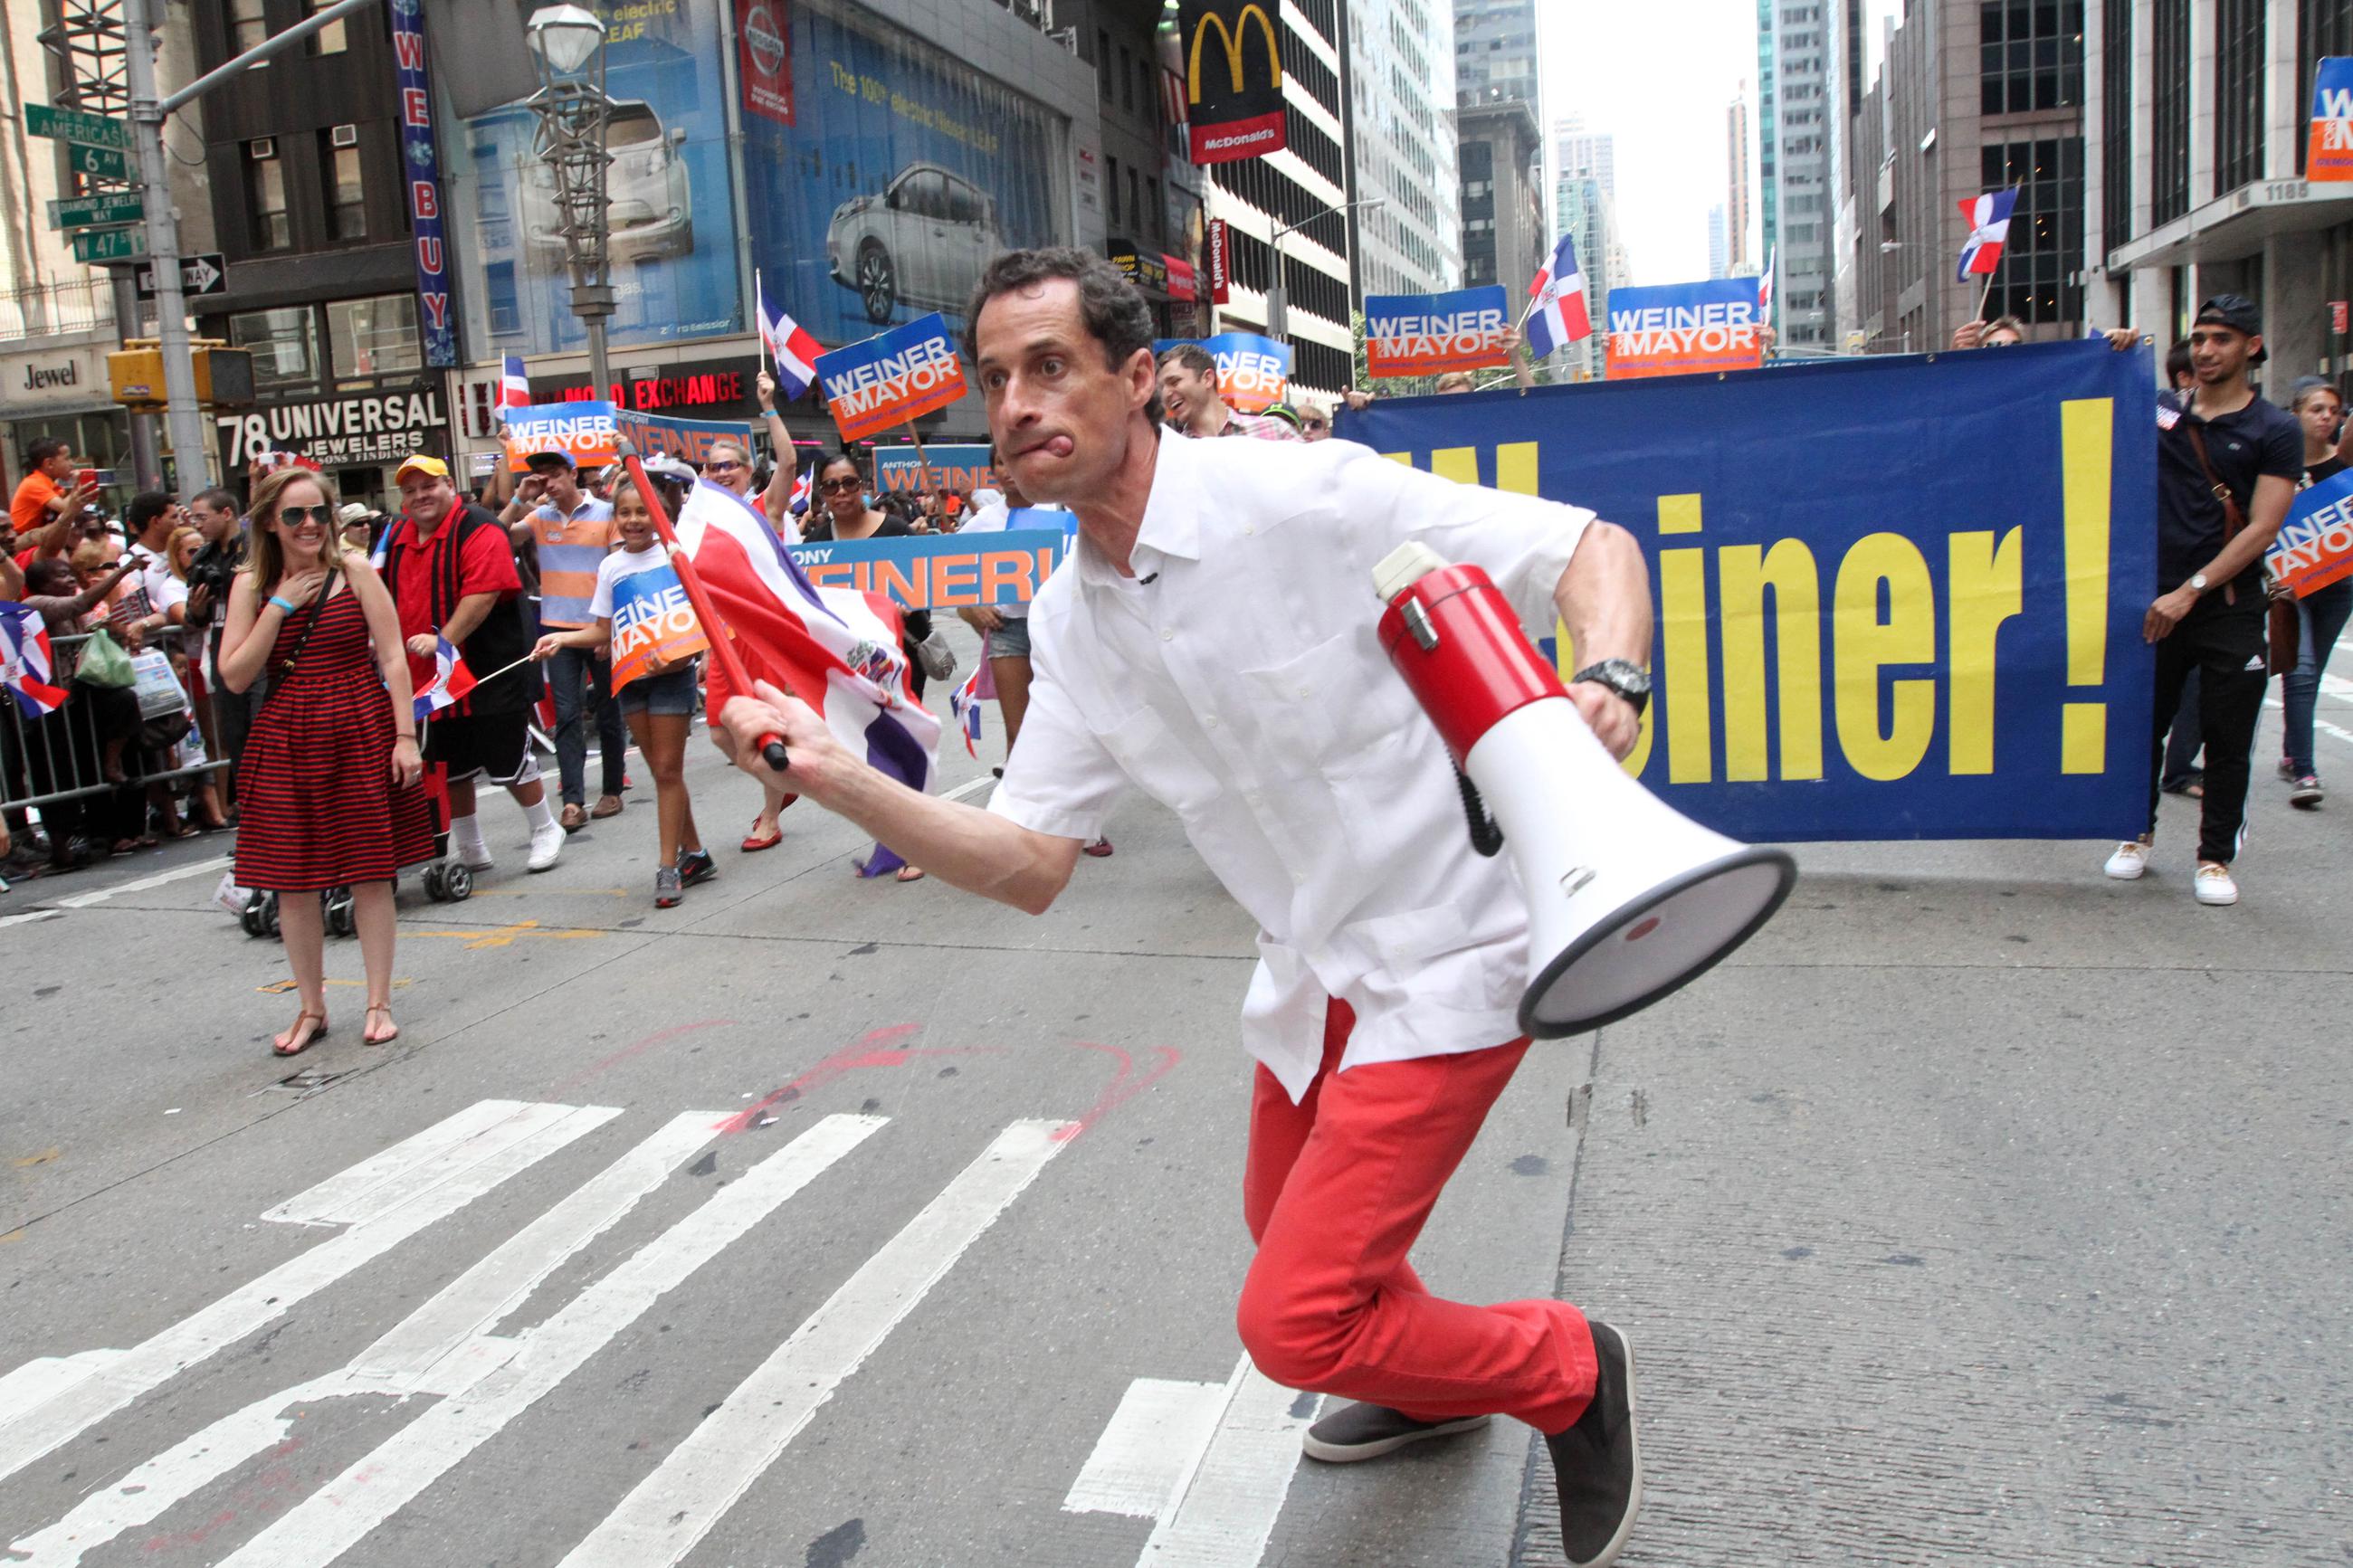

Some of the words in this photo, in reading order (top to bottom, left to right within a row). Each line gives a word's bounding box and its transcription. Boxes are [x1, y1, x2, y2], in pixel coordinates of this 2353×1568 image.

[614, 0, 676, 22] electric
[830, 61, 856, 94] The
[40, 119, 121, 147] AMERICAS
[1205, 128, 1275, 150] McDonald's
[85, 149, 99, 172] 6
[104, 153, 118, 165] AV
[393, 32, 430, 127] WE
[412, 181, 449, 330] BUY
[60, 198, 98, 214] DIAMOND
[102, 193, 141, 209] JEWELRY
[91, 208, 112, 222] WAY
[75, 236, 89, 260] W
[96, 233, 116, 256] 47
[1211, 222, 1224, 290] McDonald's
[1369, 309, 1504, 338] WEINER
[1611, 301, 1752, 333] WEINER
[1384, 331, 1505, 358] MAYOR
[1624, 326, 1754, 356] MAYOR
[24, 359, 76, 390] Jewel
[825, 336, 951, 396] WEINER
[1214, 351, 1281, 376] NER
[533, 383, 625, 410] DIAMOD
[634, 372, 745, 410] EXCHANGE
[847, 356, 958, 416] MAYOR
[1218, 369, 1281, 394] YOR
[217, 413, 272, 467] 78
[271, 392, 446, 441] UNIVERSAL
[509, 416, 613, 438] WEINER
[300, 431, 424, 457] JEWELERS
[520, 432, 614, 452] MAYOR
[882, 466, 1000, 494] WEINE
[793, 548, 833, 565] ONY
[802, 547, 1053, 609] EINER!
[1380, 397, 2114, 784] iner!
[613, 584, 691, 637] EINE
[612, 605, 697, 670] MAYO
